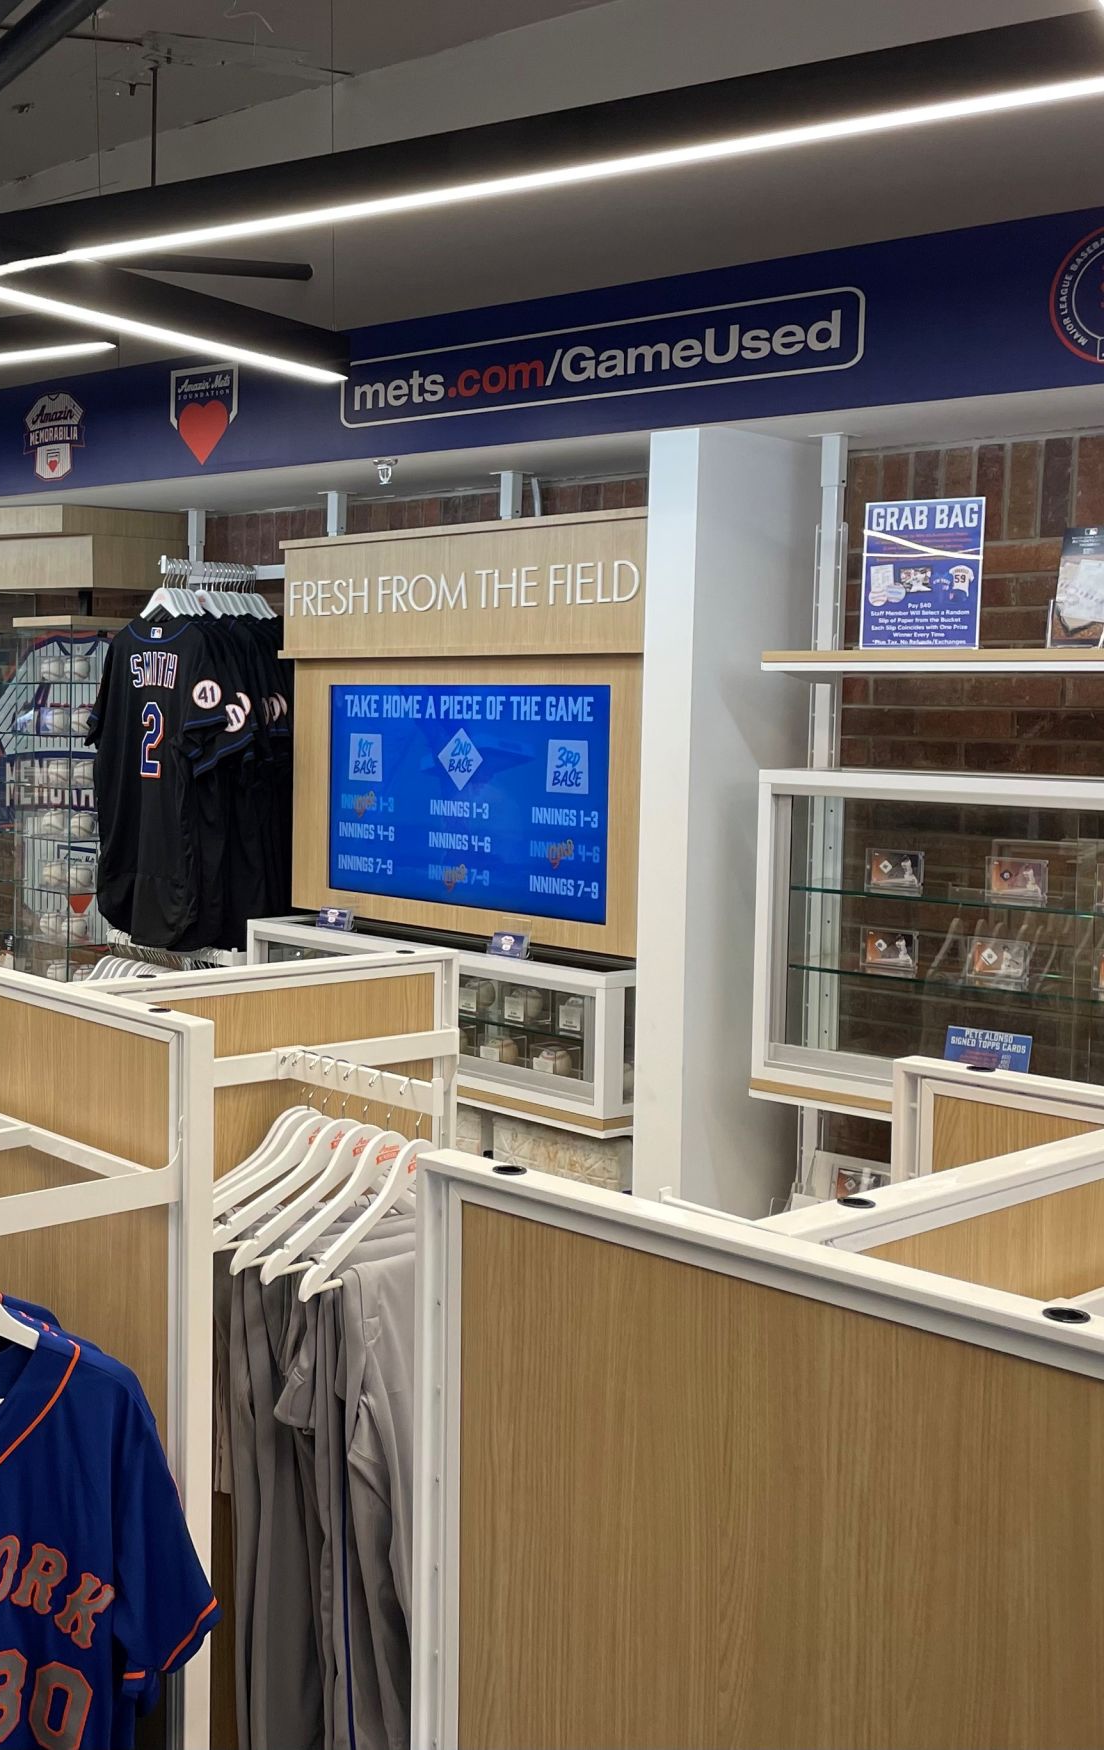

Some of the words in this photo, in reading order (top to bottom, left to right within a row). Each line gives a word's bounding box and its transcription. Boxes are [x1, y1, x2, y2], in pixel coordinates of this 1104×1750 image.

[1059, 274, 1073, 315] LEAGUE
[354, 309, 842, 410] mets.com/GameUsed
[31, 404, 76, 424] Amazin'
[29, 426, 78, 446] MEMORABILIA
[872, 506, 928, 531] GRAB
[935, 503, 979, 529] BAG
[289, 578, 369, 617] FRESH
[377, 572, 468, 613] FROM
[474, 566, 539, 609] THE
[547, 560, 641, 605] FIELD
[130, 651, 178, 689] SMITH
[198, 685, 215, 703] 41
[345, 694, 379, 718] TAKE
[382, 695, 422, 718] HOME
[425, 695, 436, 719] A
[439, 695, 482, 720] PIECE
[485, 696, 506, 720] OF
[510, 696, 541, 721] THE
[545, 696, 594, 722] GAME
[140, 701, 165, 778] 2
[358, 738, 374, 758] 1ST
[451, 738, 472, 757] 2ND
[353, 758, 379, 776] BASE
[448, 757, 474, 774] BASE
[555, 746, 581, 769] 3RD
[552, 768, 583, 788] BASE
[430, 799, 470, 818] INNINGS
[472, 802, 489, 820] 1-3
[531, 806, 577, 827] INNINGS
[579, 810, 599, 829] 1-3
[339, 821, 375, 839] INNINGS
[377, 824, 395, 842] 4-6
[429, 831, 469, 850] INNINGS
[471, 834, 491, 853] 4-6
[338, 854, 374, 872] INNINGS
[375, 857, 393, 875] 7-9
[578, 844, 600, 864] 4-6
[470, 868, 490, 887] 7-9
[529, 875, 575, 896] INNINGS
[577, 879, 599, 900] 7-9
[951, 1036, 976, 1047] SIGNED
[978, 1040, 1000, 1051] TOPPS
[1002, 1043, 1026, 1054] CARDS
[965, 1030, 983, 1040] PETE
